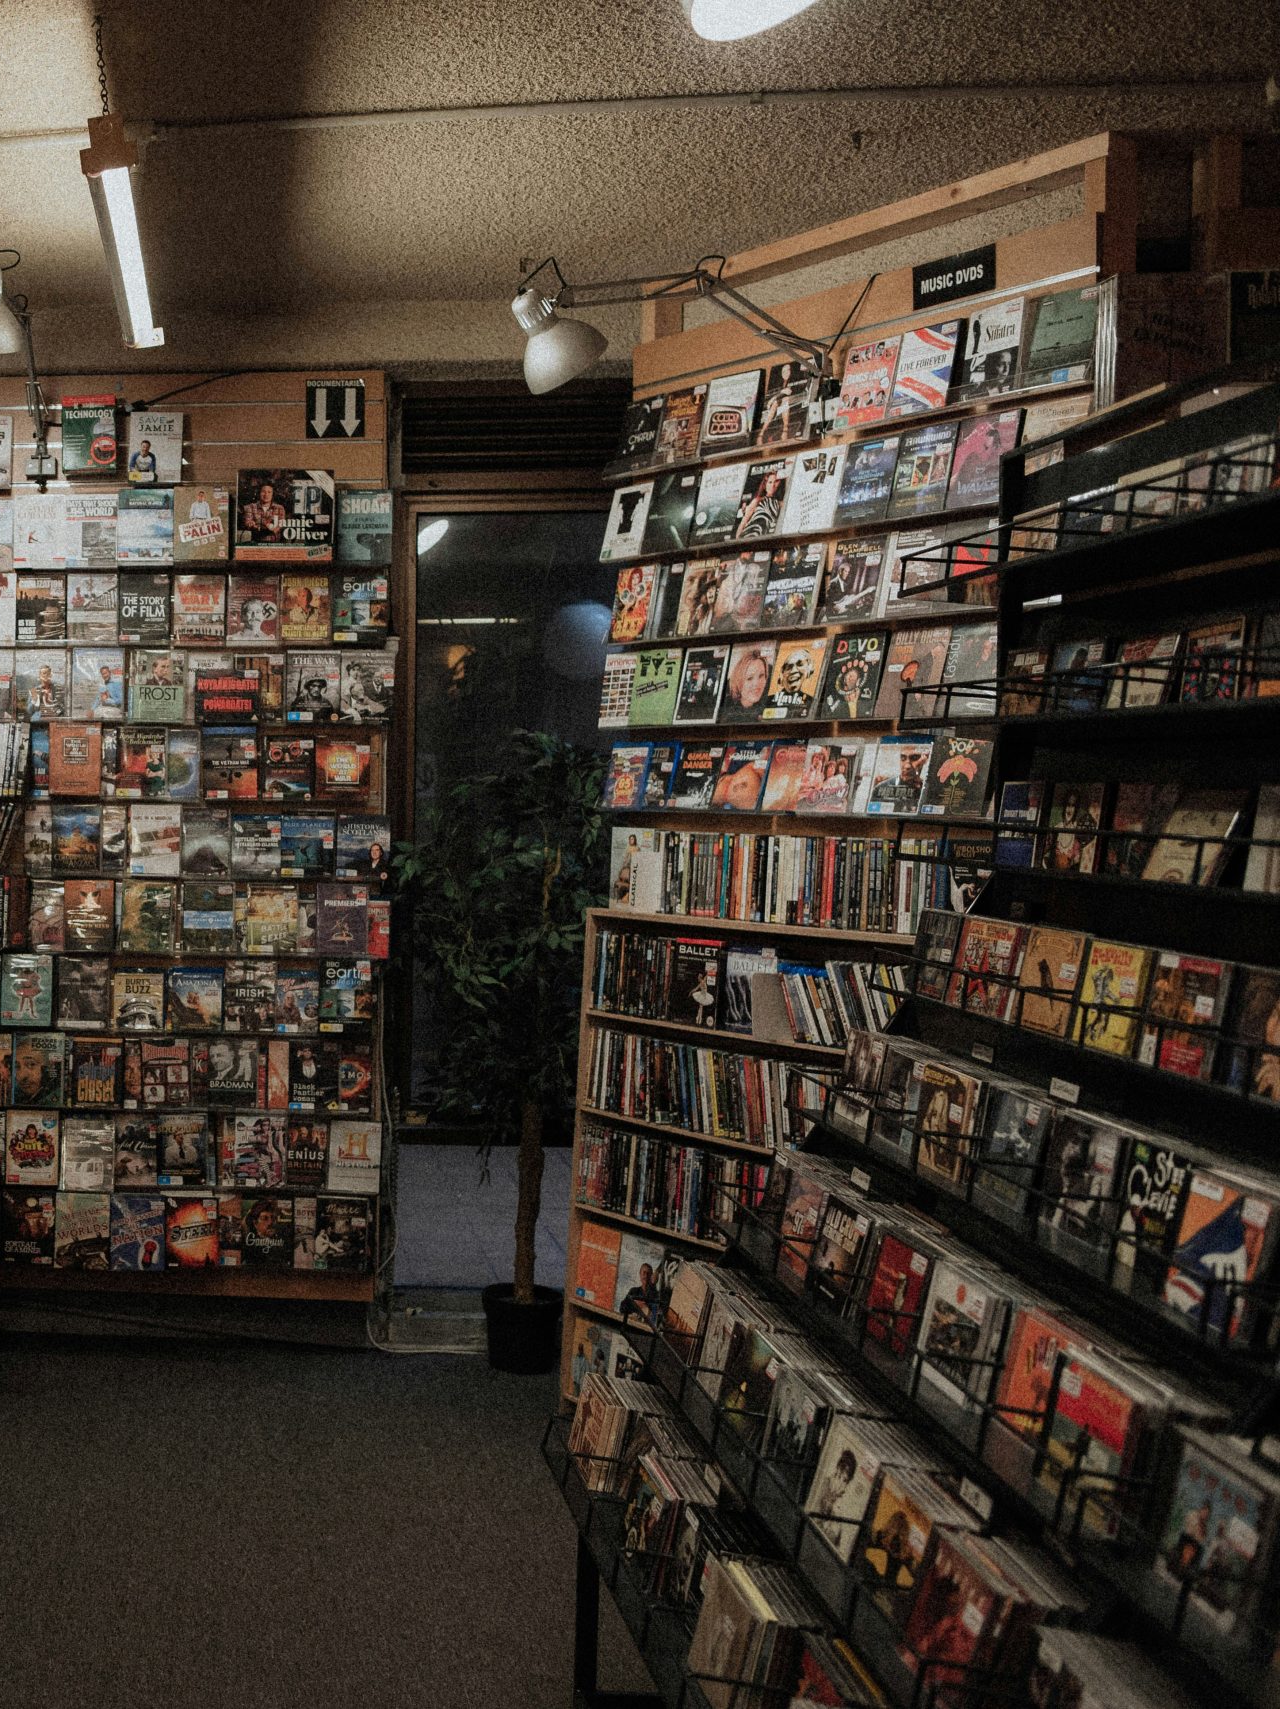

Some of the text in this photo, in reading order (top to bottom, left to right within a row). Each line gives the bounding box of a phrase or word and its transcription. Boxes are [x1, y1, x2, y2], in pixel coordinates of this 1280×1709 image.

[921, 264, 984, 295] MUSIC DVDS
[900, 353, 947, 373] LIVE FOREVER
[65, 409, 114, 418] TECHNOLOGY
[138, 424, 174, 432] JAMIE
[85, 506, 113, 517] WORLD
[269, 514, 314, 528] Jamie
[184, 524, 222, 539] PALIN
[283, 529, 329, 541] Oliver
[123, 597, 165, 605] THE STORY
[122, 606, 165, 617] OF FILM
[836, 637, 878, 654] DEVO
[293, 657, 336, 665] THE WAR
[139, 687, 178, 700] FROST
[951, 740, 975, 753] POP
[683, 761, 713, 769] DANGER
[334, 774, 351, 782] WAR
[630, 863, 639, 907] CLASSICAL
[678, 944, 718, 956] BALLET
[733, 961, 767, 972] BALLET
[176, 979, 218, 988] AMAZONIA
[125, 985, 151, 994] BUZZ
[235, 988, 265, 998] IRISH
[209, 1081, 254, 1089] BRADMAN
[288, 1150, 325, 1161] ENIUS
[57, 1223, 108, 1241] WORLDS
[112, 1225, 164, 1246] NATION
[171, 1223, 213, 1241] STEEL
